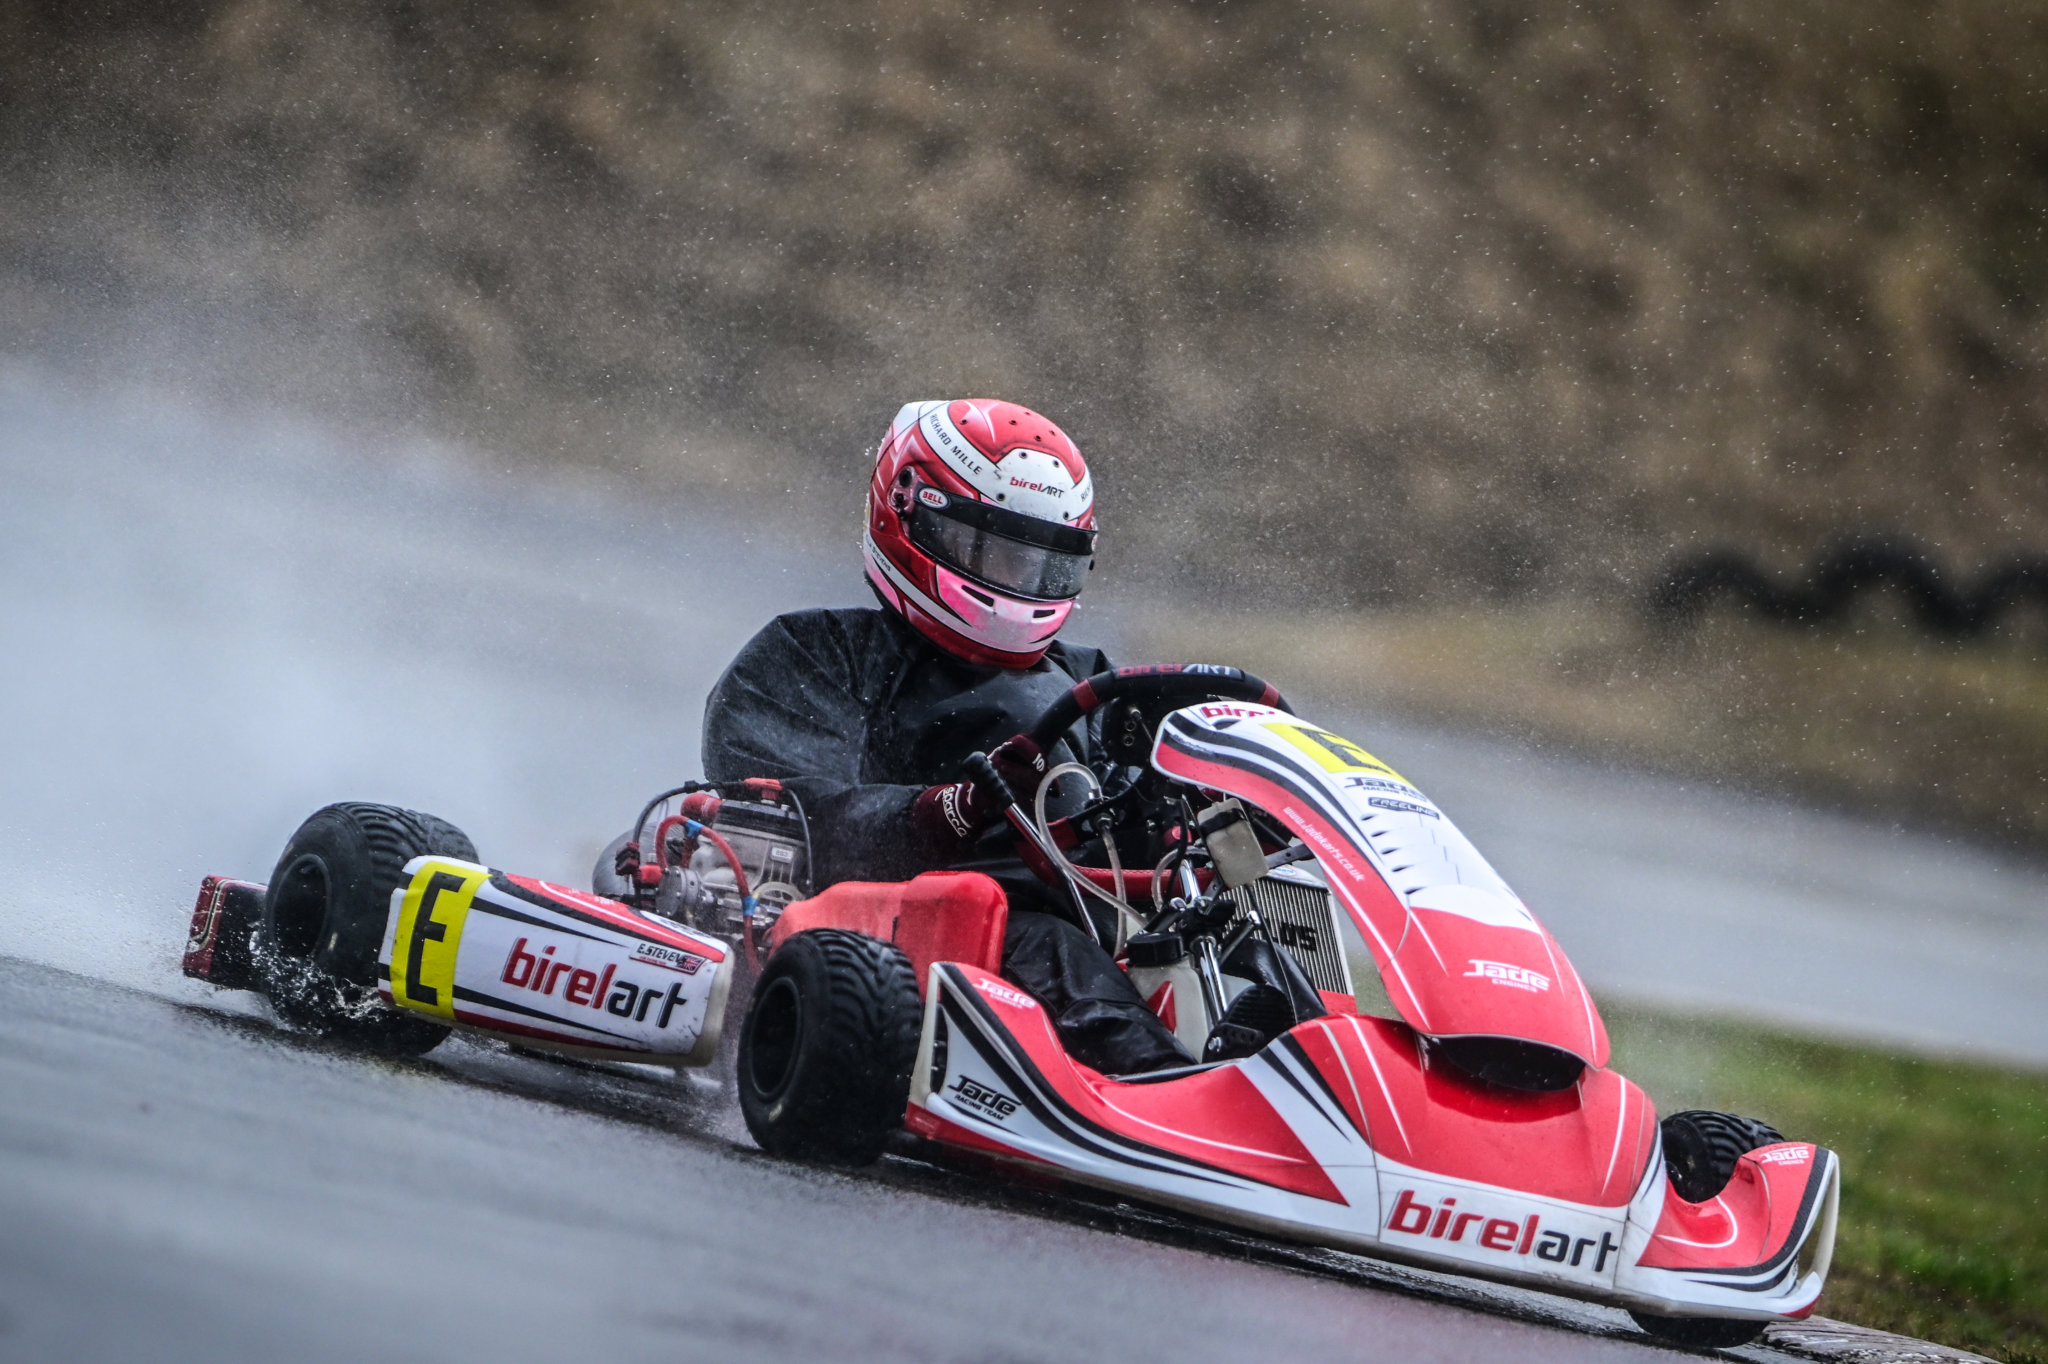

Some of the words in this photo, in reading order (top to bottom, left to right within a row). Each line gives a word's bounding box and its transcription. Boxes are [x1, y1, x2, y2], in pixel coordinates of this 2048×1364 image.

[929, 413, 952, 446] RICHARD
[951, 445, 983, 475] MILLE
[922, 490, 943, 505] BELL
[1009, 476, 1065, 499] birelART
[942, 786, 968, 838] sparco
[406, 870, 468, 1006] E
[501, 937, 688, 1029] birelart
[1463, 959, 1551, 992] Jade
[1491, 978, 1538, 993] ENGINES
[972, 977, 1037, 1008] Jade
[947, 1075, 1022, 1116] Jade
[954, 1094, 981, 1110] RACING
[982, 1107, 1004, 1121] TEAM
[1759, 1146, 1810, 1164] Jade
[1384, 1189, 1618, 1273] birelart
